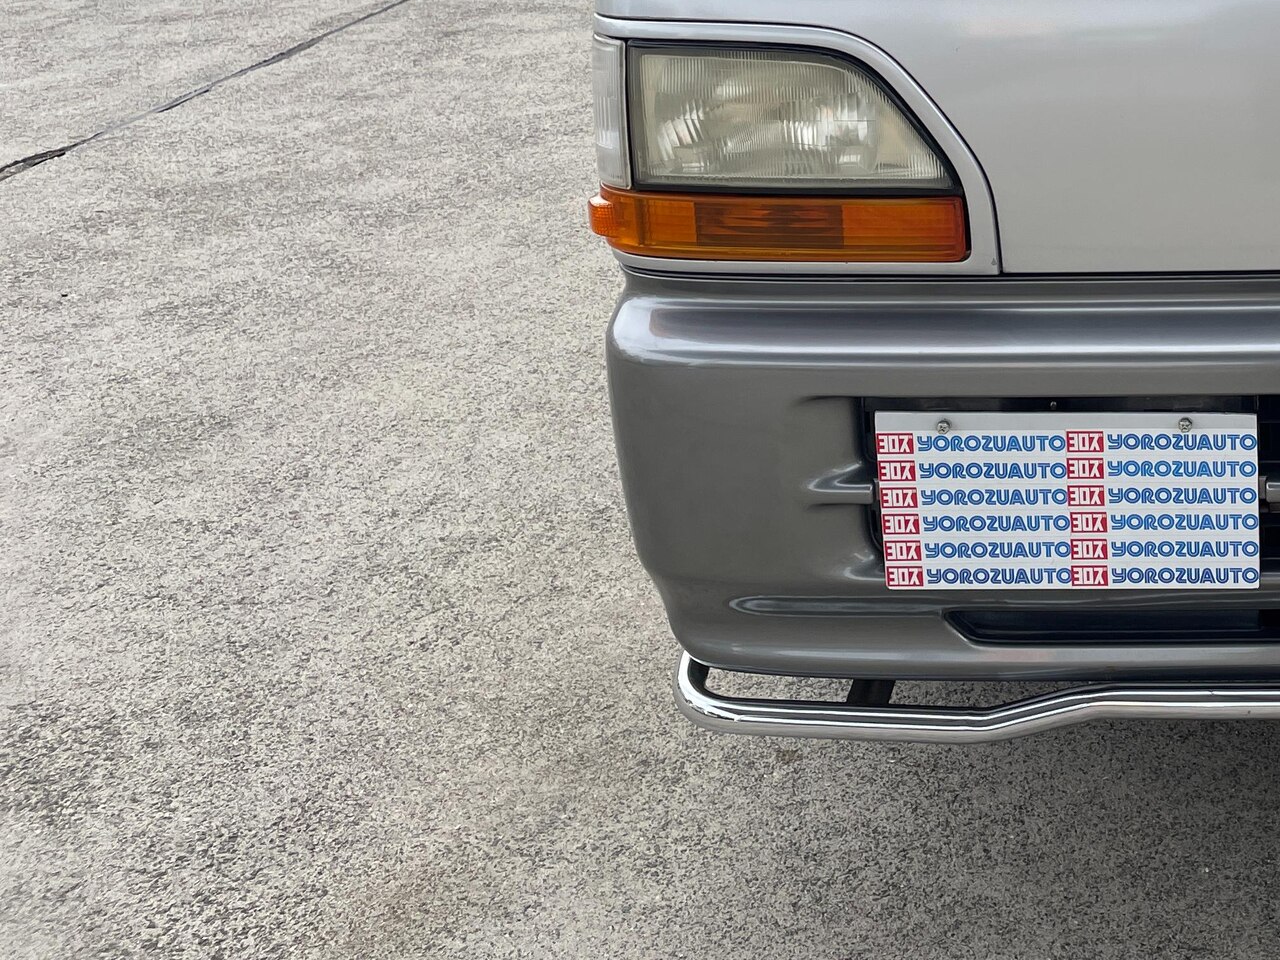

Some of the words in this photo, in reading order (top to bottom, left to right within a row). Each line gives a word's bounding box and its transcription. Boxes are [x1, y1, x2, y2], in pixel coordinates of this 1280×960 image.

[917, 435, 1066, 452] YOROZUAUTO
[1107, 433, 1257, 451] YOROZUAUTO
[919, 462, 1067, 479] YOROZUAUTO
[1107, 460, 1257, 477] YOROZUAUTO
[921, 488, 1067, 505] YOROZUAUTO
[1108, 487, 1257, 504] YOROZUAUTO
[923, 514, 1070, 532] YOROZUAUTO
[1110, 513, 1259, 531] YOROZUAUTO
[925, 541, 1071, 558] YOROZUAUTO
[1111, 540, 1259, 557] YOROZUAUTO
[926, 567, 1072, 584] YOROZUAUTO
[1111, 567, 1260, 584] YOROZUAUTO
